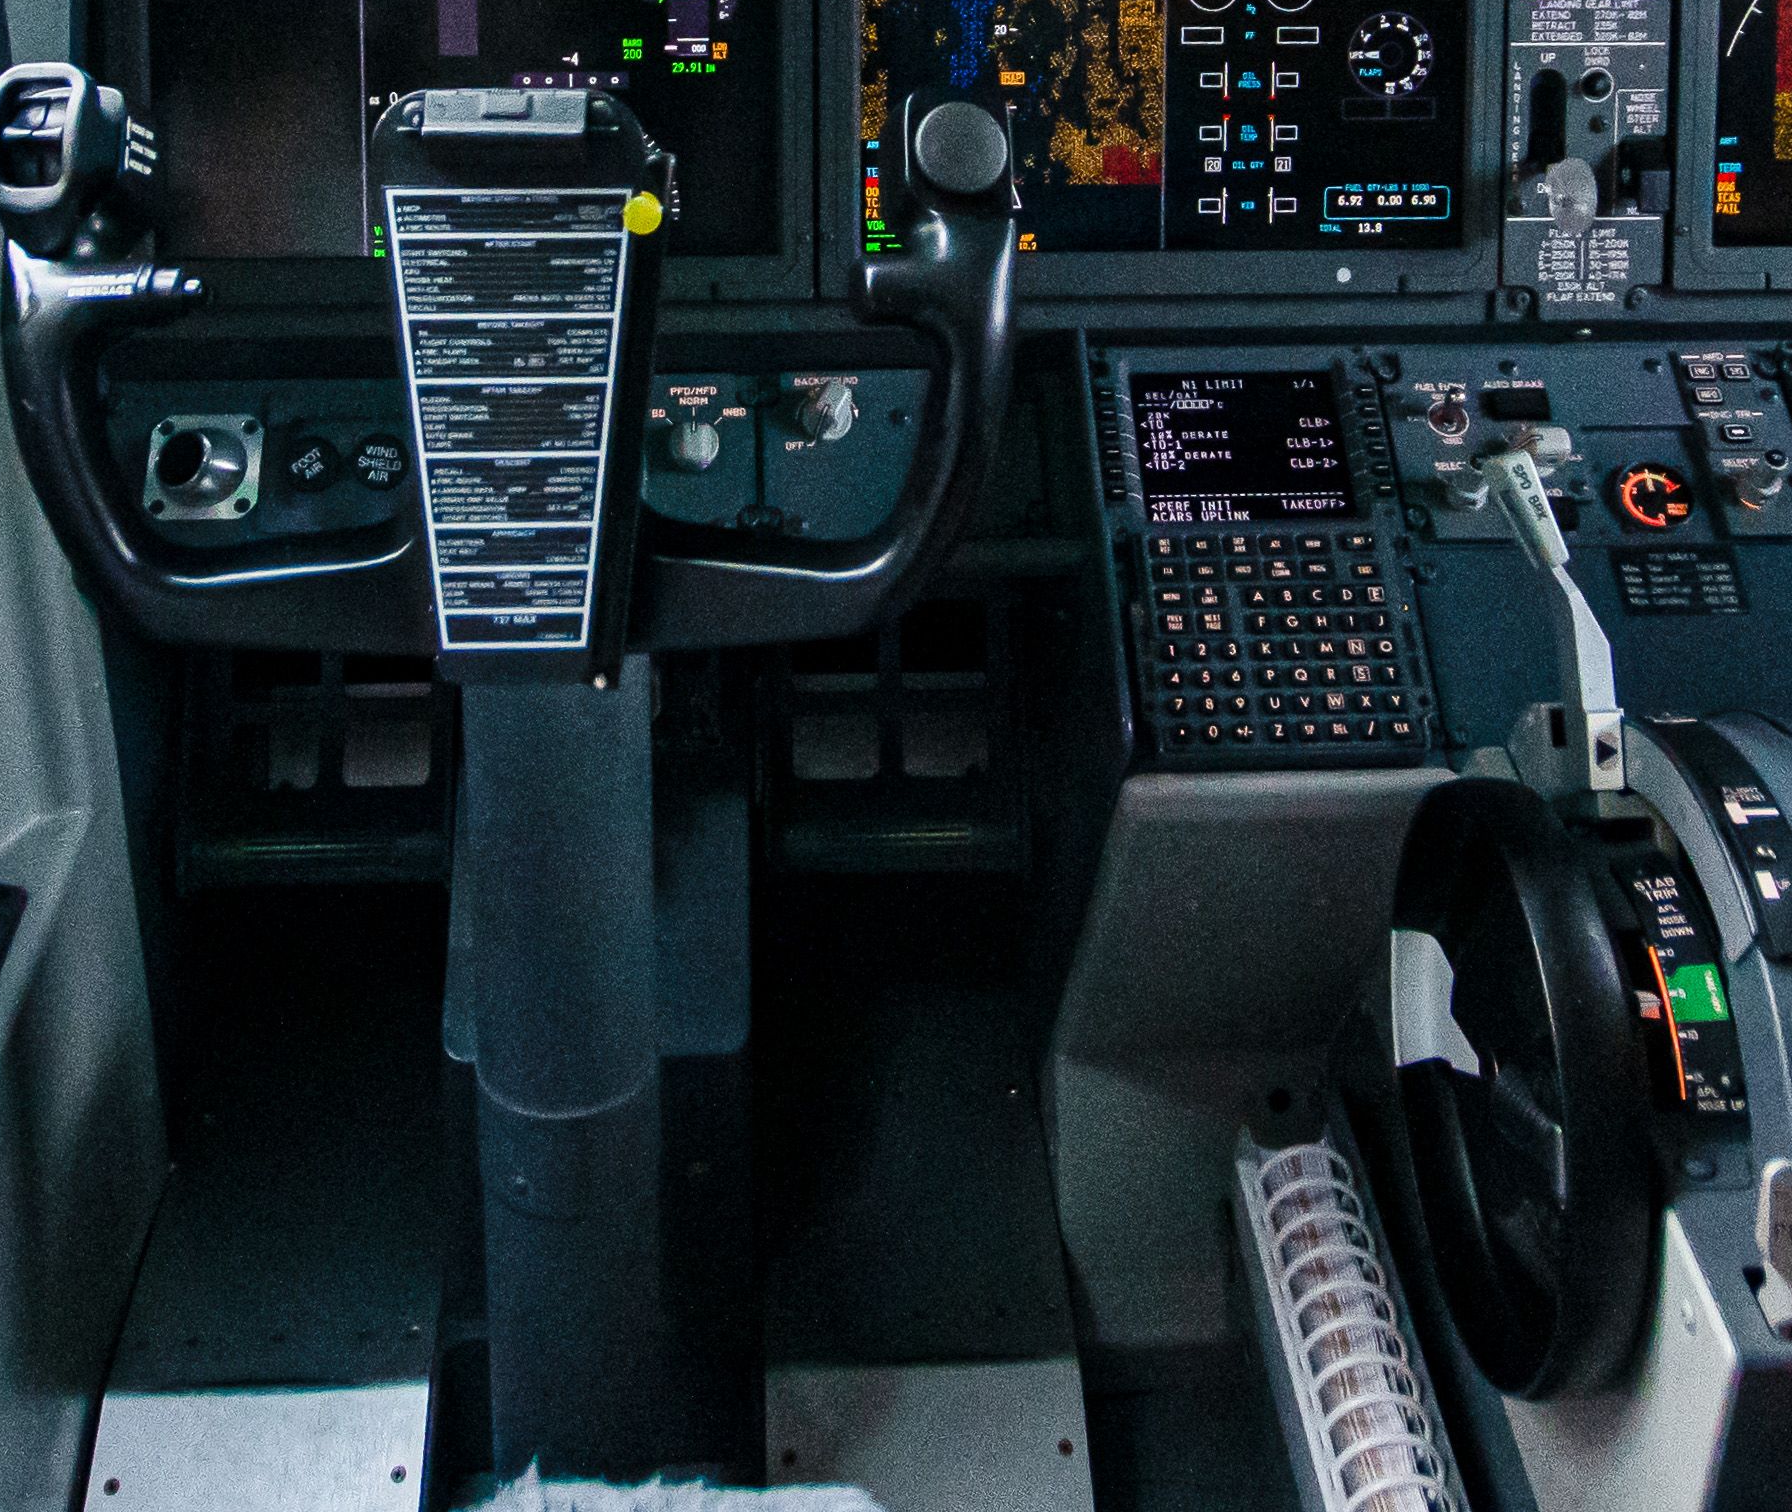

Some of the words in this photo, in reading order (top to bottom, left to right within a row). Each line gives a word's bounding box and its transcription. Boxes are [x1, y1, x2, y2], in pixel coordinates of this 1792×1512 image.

[623, 49, 642, 59] 200
[1540, 53, 1555, 63] UP
[679, 397, 708, 405] NORM
[366, 445, 398, 458] WIND
[358, 457, 402, 470] SHIELD
[368, 471, 389, 482] AIR
[1201, 501, 1231, 510] INIT
[1153, 512, 1192, 521] ACARS
[1201, 511, 1250, 520] UPLINK
[1635, 877, 1675, 890] STAB
[1645, 887, 1678, 901] TRIM
